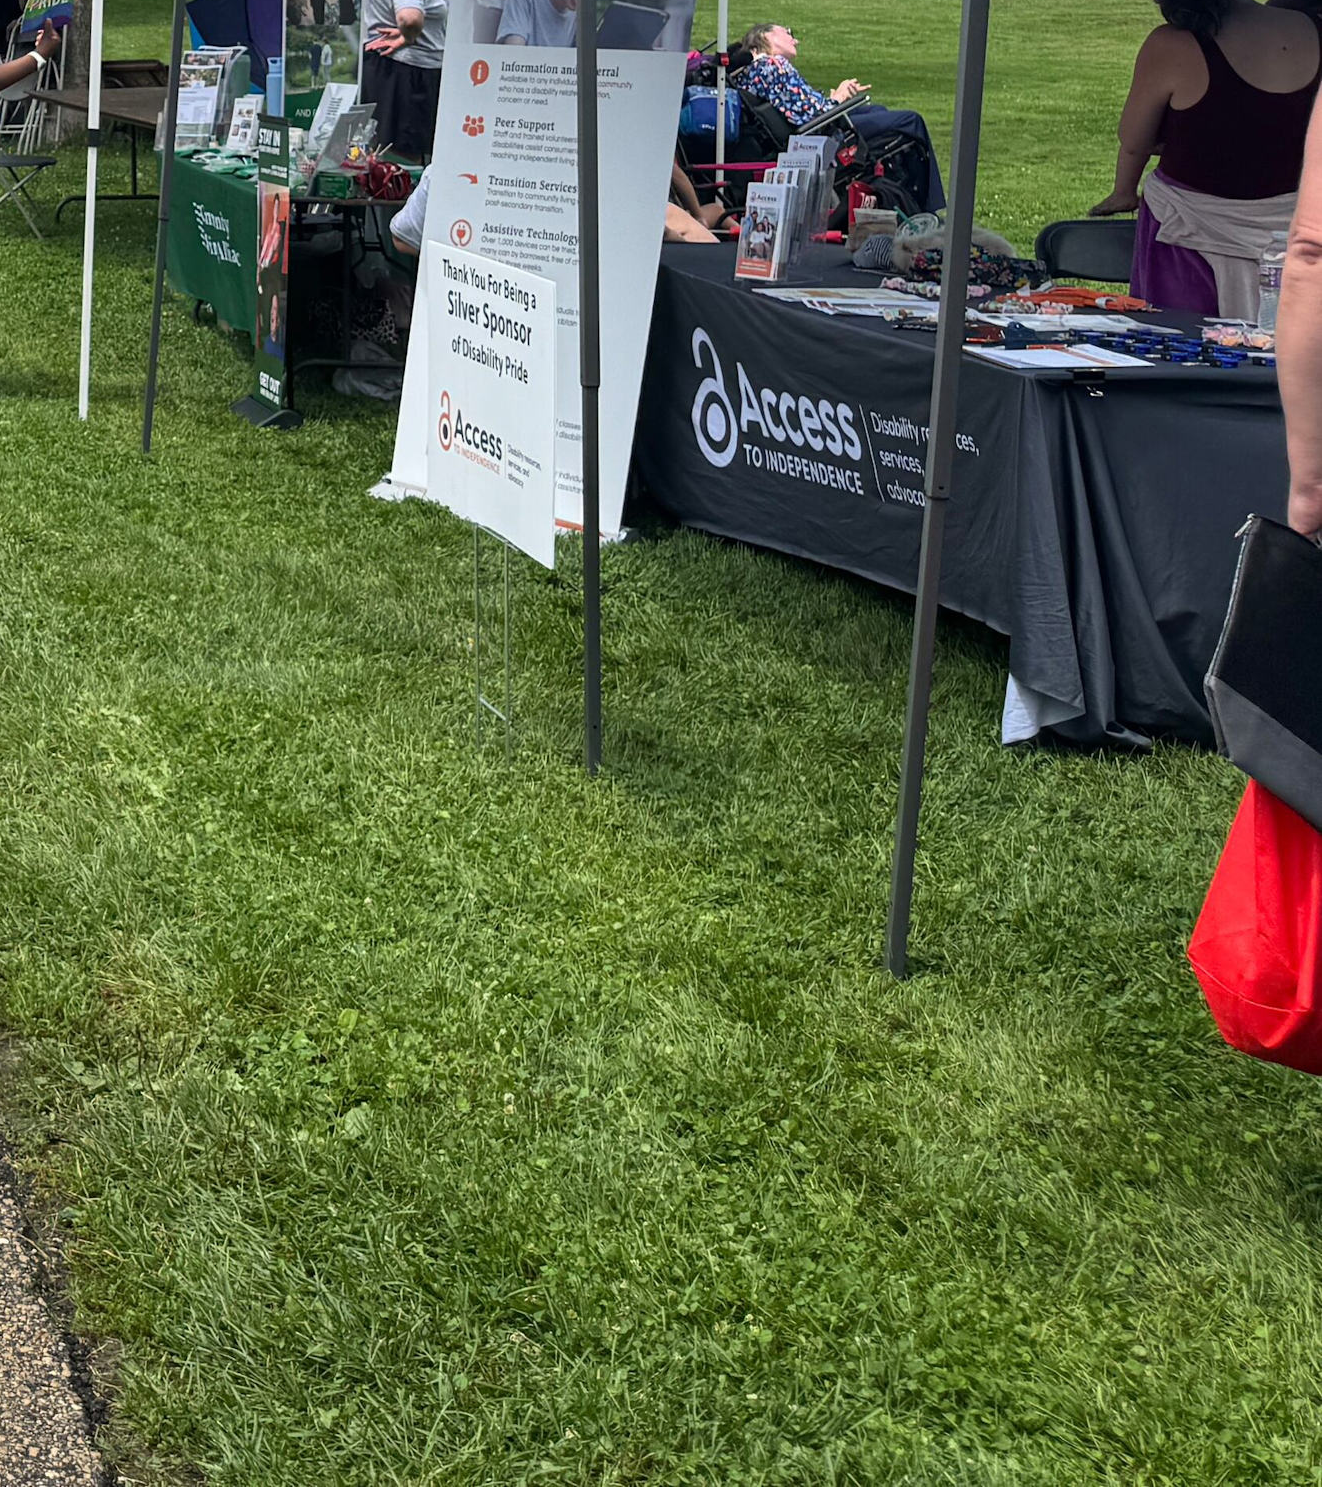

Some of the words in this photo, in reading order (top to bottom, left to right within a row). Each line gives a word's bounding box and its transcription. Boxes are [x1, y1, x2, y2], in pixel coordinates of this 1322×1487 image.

[499, 75, 528, 83] Available
[537, 78, 548, 86] any
[501, 61, 558, 74] Information
[597, 66, 620, 78] erral
[498, 85, 512, 93] who
[513, 86, 525, 94] has
[295, 108, 312, 118] AND
[495, 117, 515, 129] Peer
[517, 118, 555, 133] Support
[509, 131, 522, 140] and
[491, 151, 518, 162] reaching
[519, 152, 558, 164] independent
[558, 157, 575, 167] living
[488, 175, 537, 190] Transition
[539, 179, 577, 194] Services
[524, 192, 559, 204] community
[560, 194, 576, 206] living
[482, 222, 524, 238] Assistive
[526, 227, 578, 246] Technology
[442, 258, 469, 285] Thank
[469, 267, 486, 290] You
[488, 274, 502, 296] For
[504, 279, 529, 312] Being
[531, 293, 537, 310] a
[447, 290, 480, 325] Silver
[483, 302, 532, 347] Sponsor
[451, 335, 461, 355] of
[462, 338, 504, 378] Disability
[505, 356, 529, 385] Pride
[736, 362, 862, 461] Access
[454, 409, 503, 461] Access
[869, 412, 921, 446] Disability
[921, 425, 980, 456] reces,
[743, 444, 763, 468] TO
[765, 450, 865, 496] INDEPENDENCE
[879, 450, 925, 477] services,
[887, 482, 927, 508] advoca
